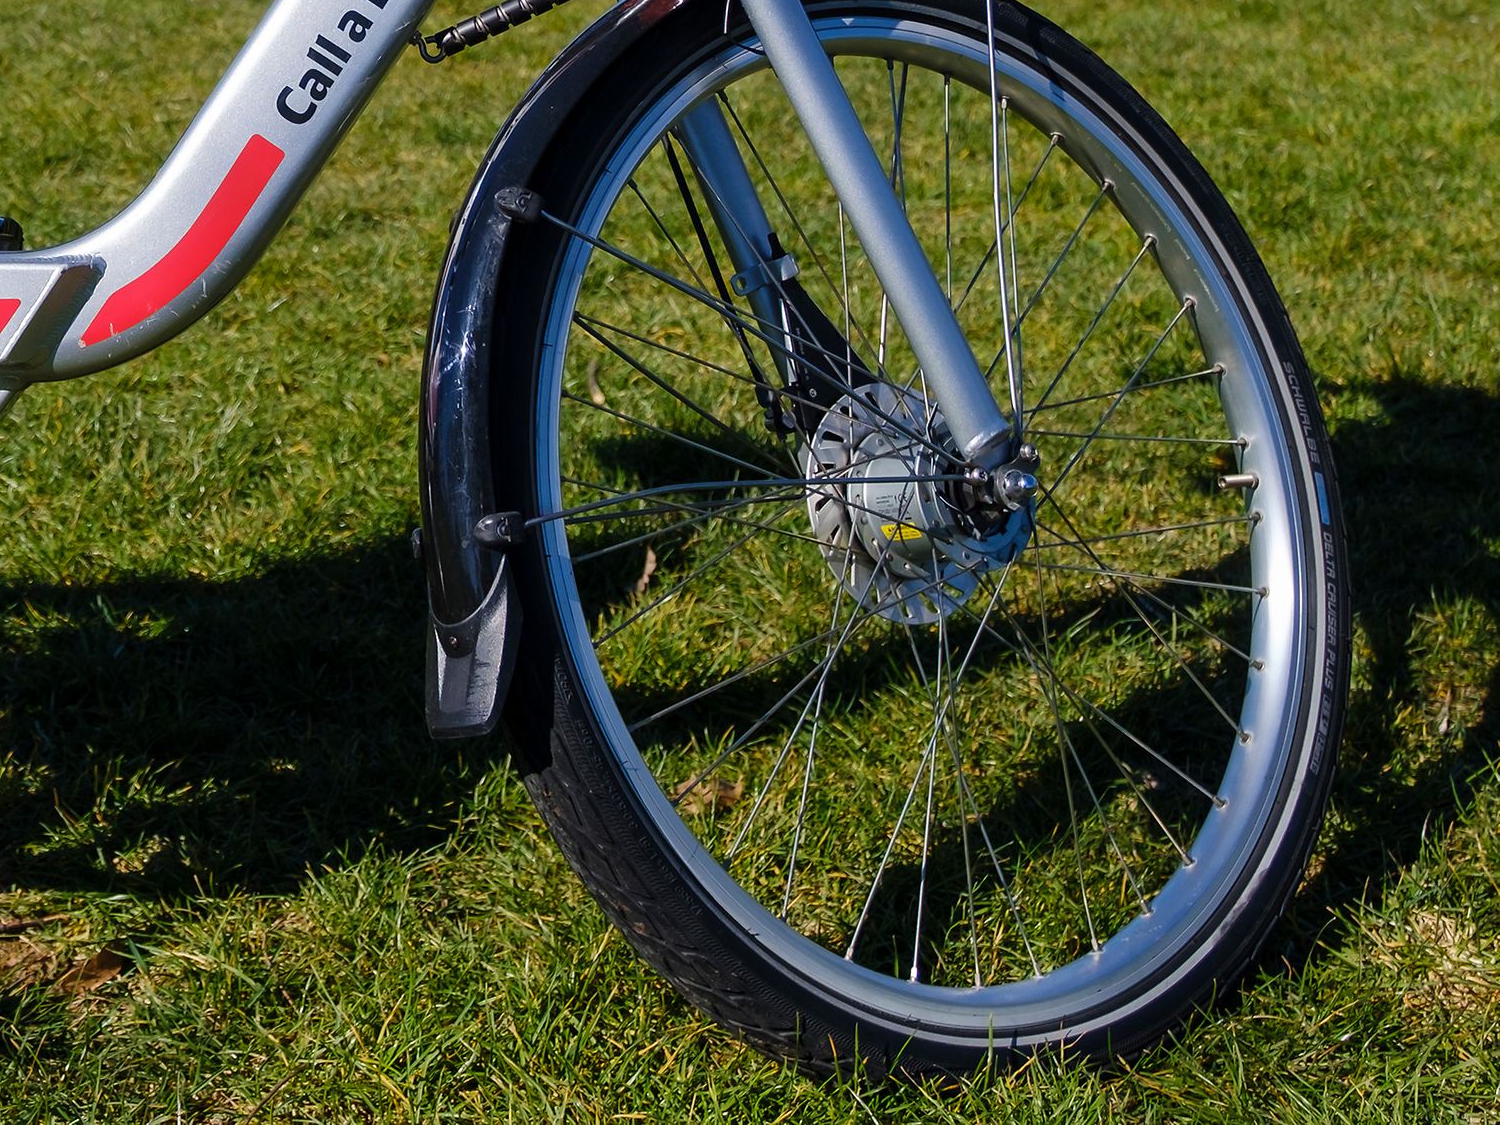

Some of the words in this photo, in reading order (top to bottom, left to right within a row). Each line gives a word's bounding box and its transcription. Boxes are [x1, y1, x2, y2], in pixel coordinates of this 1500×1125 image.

[276, 33, 353, 125] Call
[337, 8, 374, 43] a
[1282, 360, 1321, 465] SCHWALBE
[1323, 532, 1336, 579] DELTA
[1326, 581, 1338, 644] CRUISER
[1323, 650, 1338, 692] PLUS
